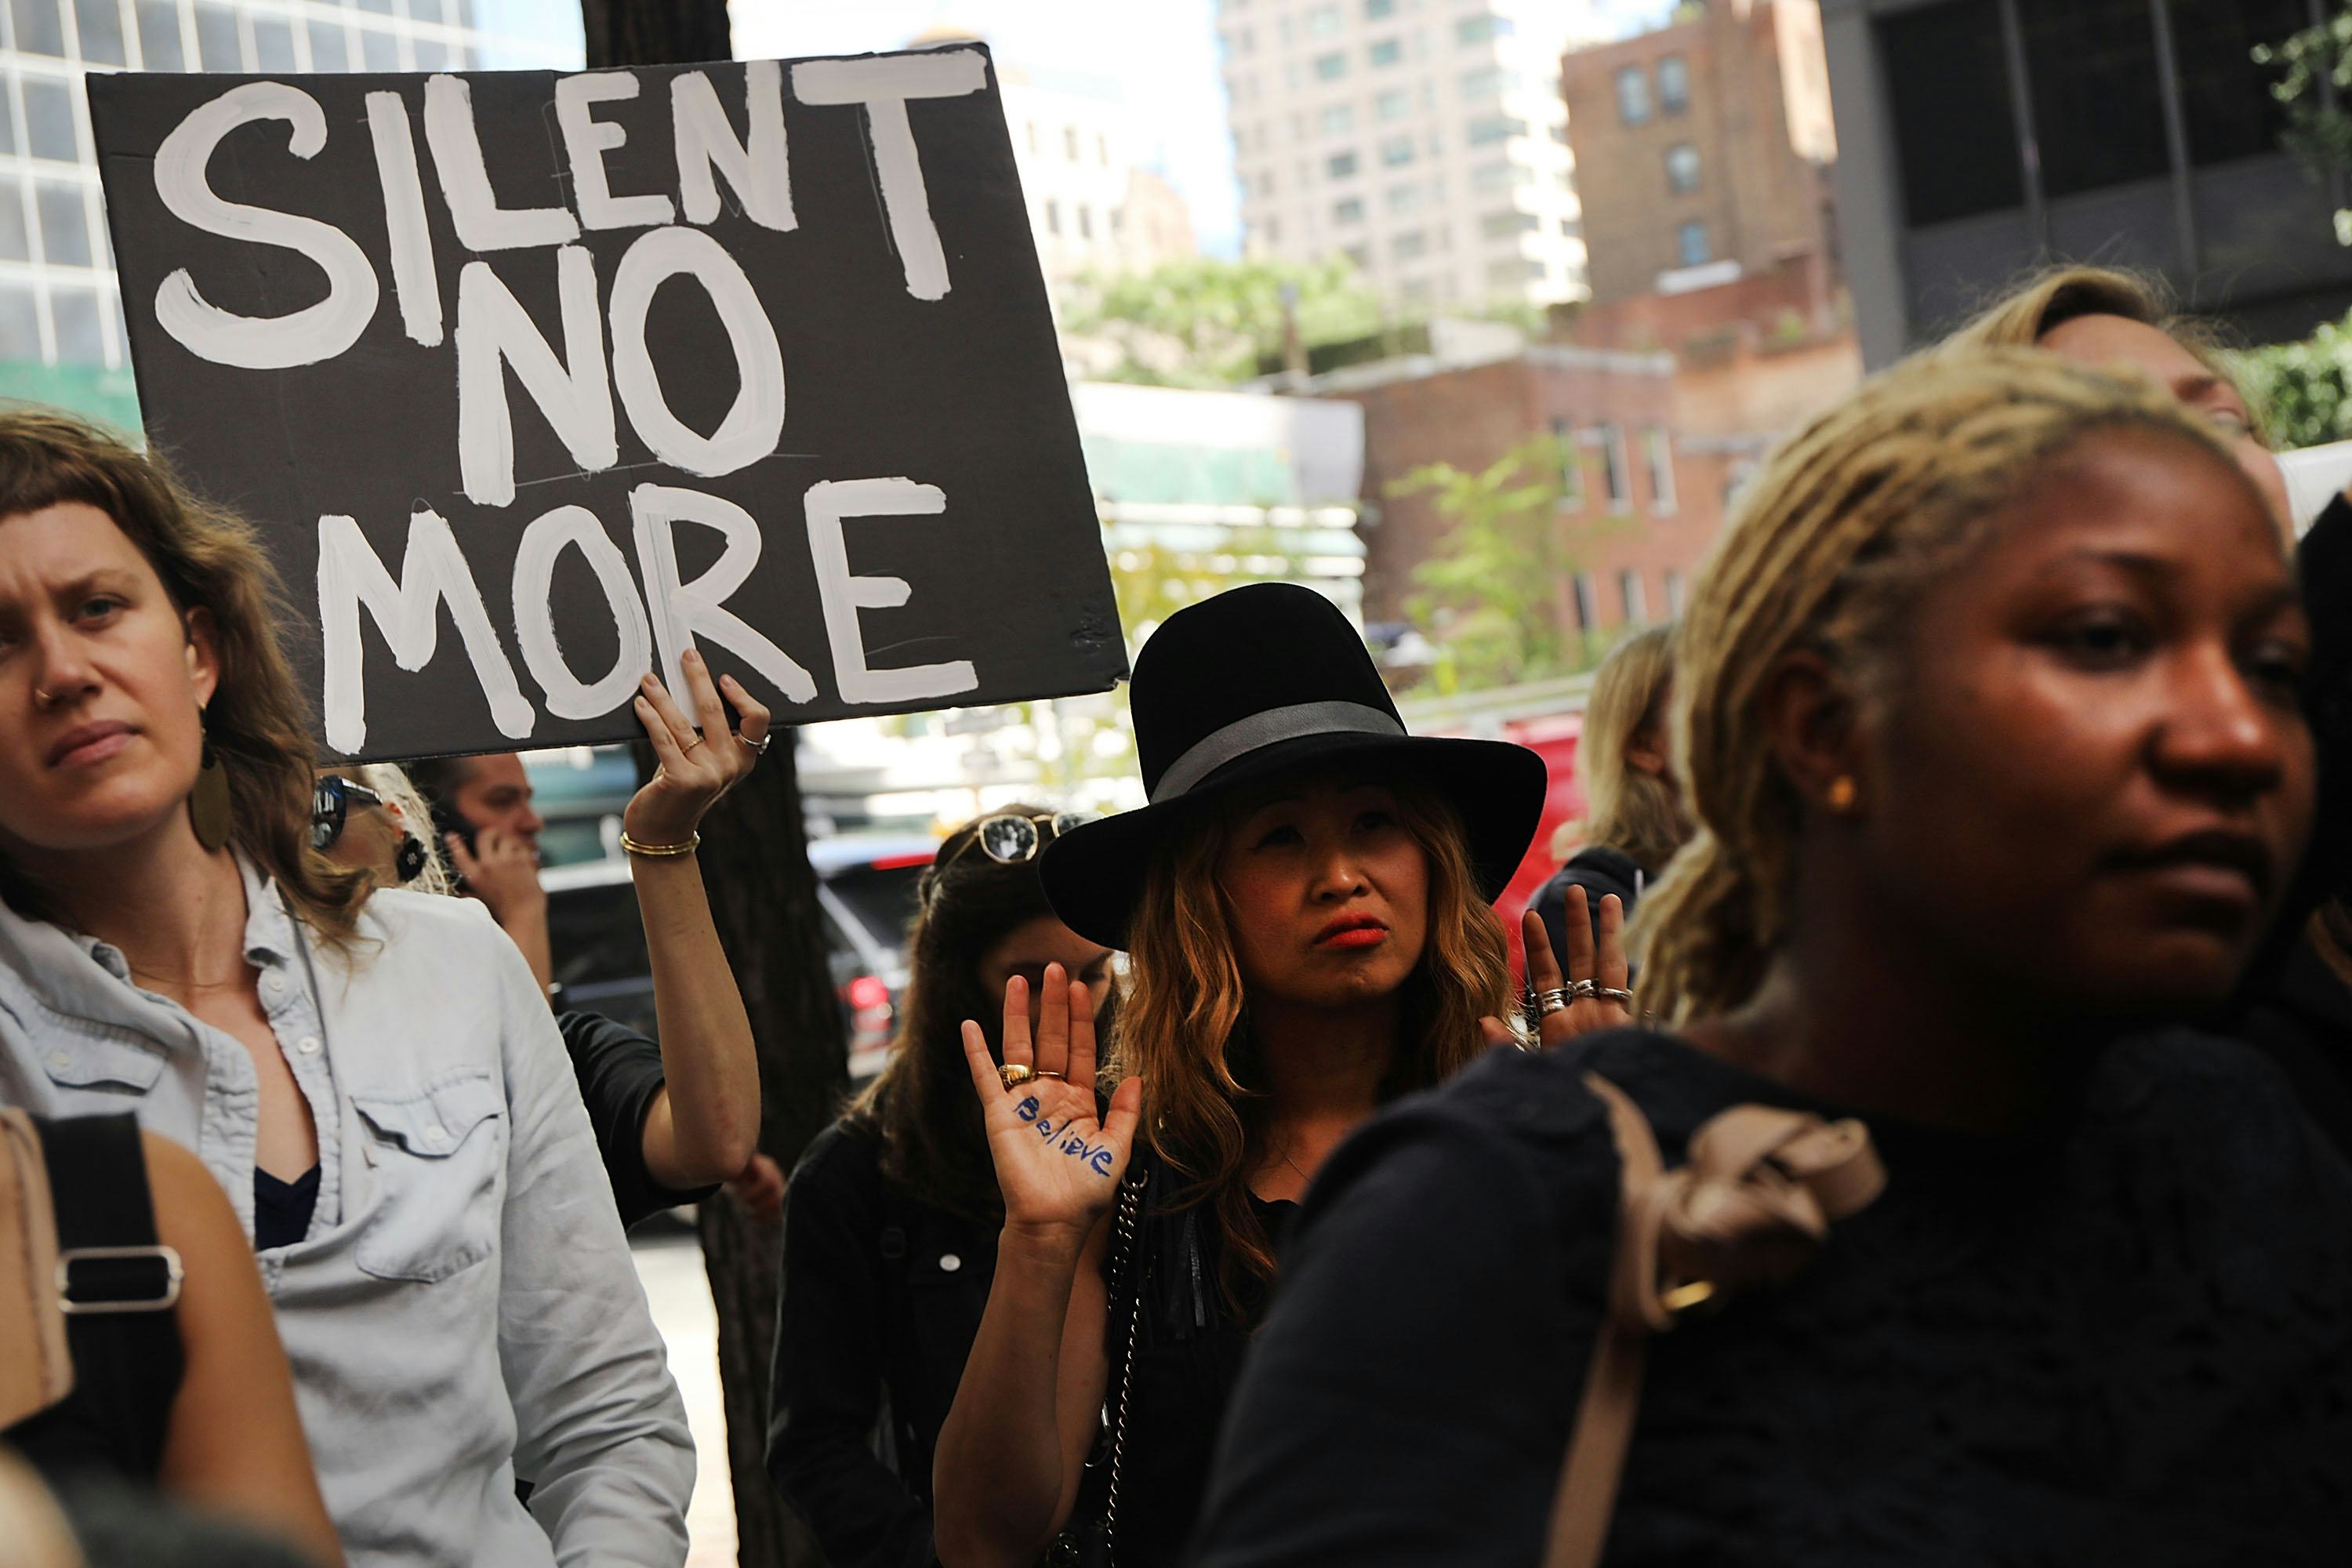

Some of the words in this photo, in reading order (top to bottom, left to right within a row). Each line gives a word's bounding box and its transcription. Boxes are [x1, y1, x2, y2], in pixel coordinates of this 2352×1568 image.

[154, 49, 987, 369] SILENT
[456, 226, 786, 507] NO
[318, 477, 978, 756] MORE
[1013, 1095, 1113, 1177] Believe
